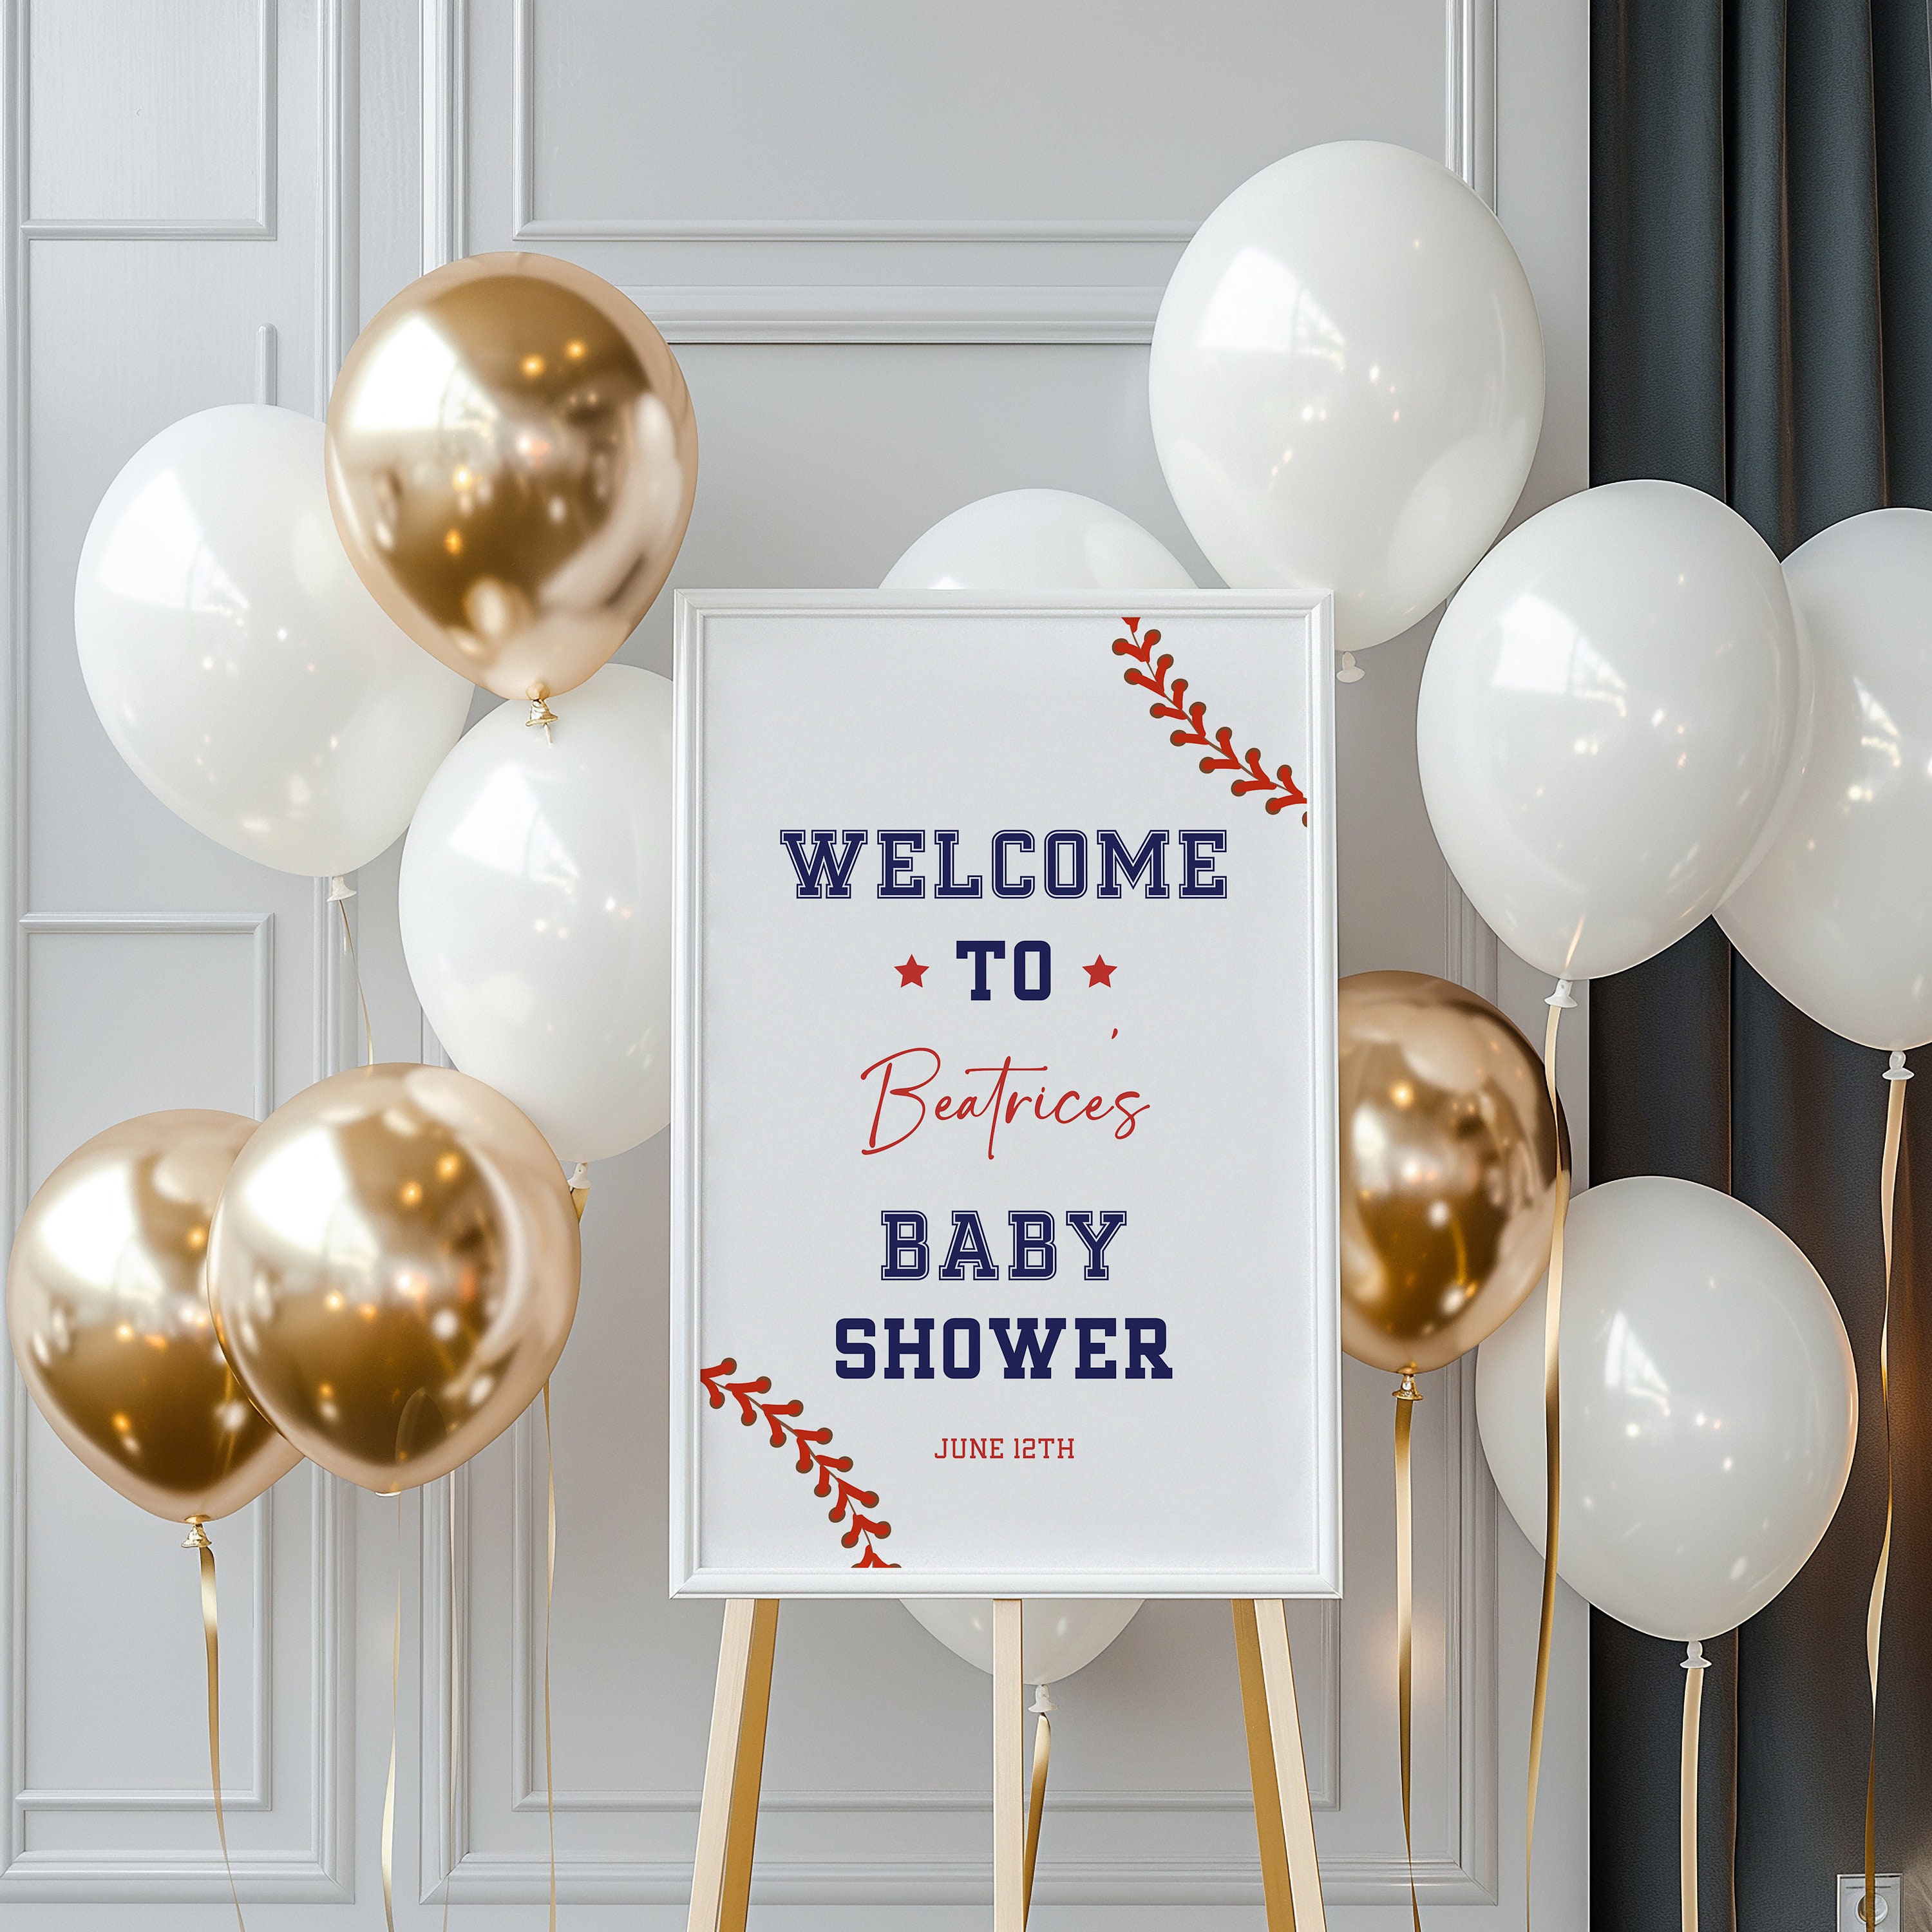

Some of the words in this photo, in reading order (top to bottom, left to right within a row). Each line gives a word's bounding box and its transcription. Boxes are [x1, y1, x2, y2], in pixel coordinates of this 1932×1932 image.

[780, 829, 1228, 900] WELCOME
[956, 940, 1051, 1001] TO
[880, 1210, 1127, 1281] BABY
[835, 1318, 1173, 1379] SHOWER
[934, 1437, 1004, 1459] JUNE
[1014, 1437, 1075, 1459] 12TH
